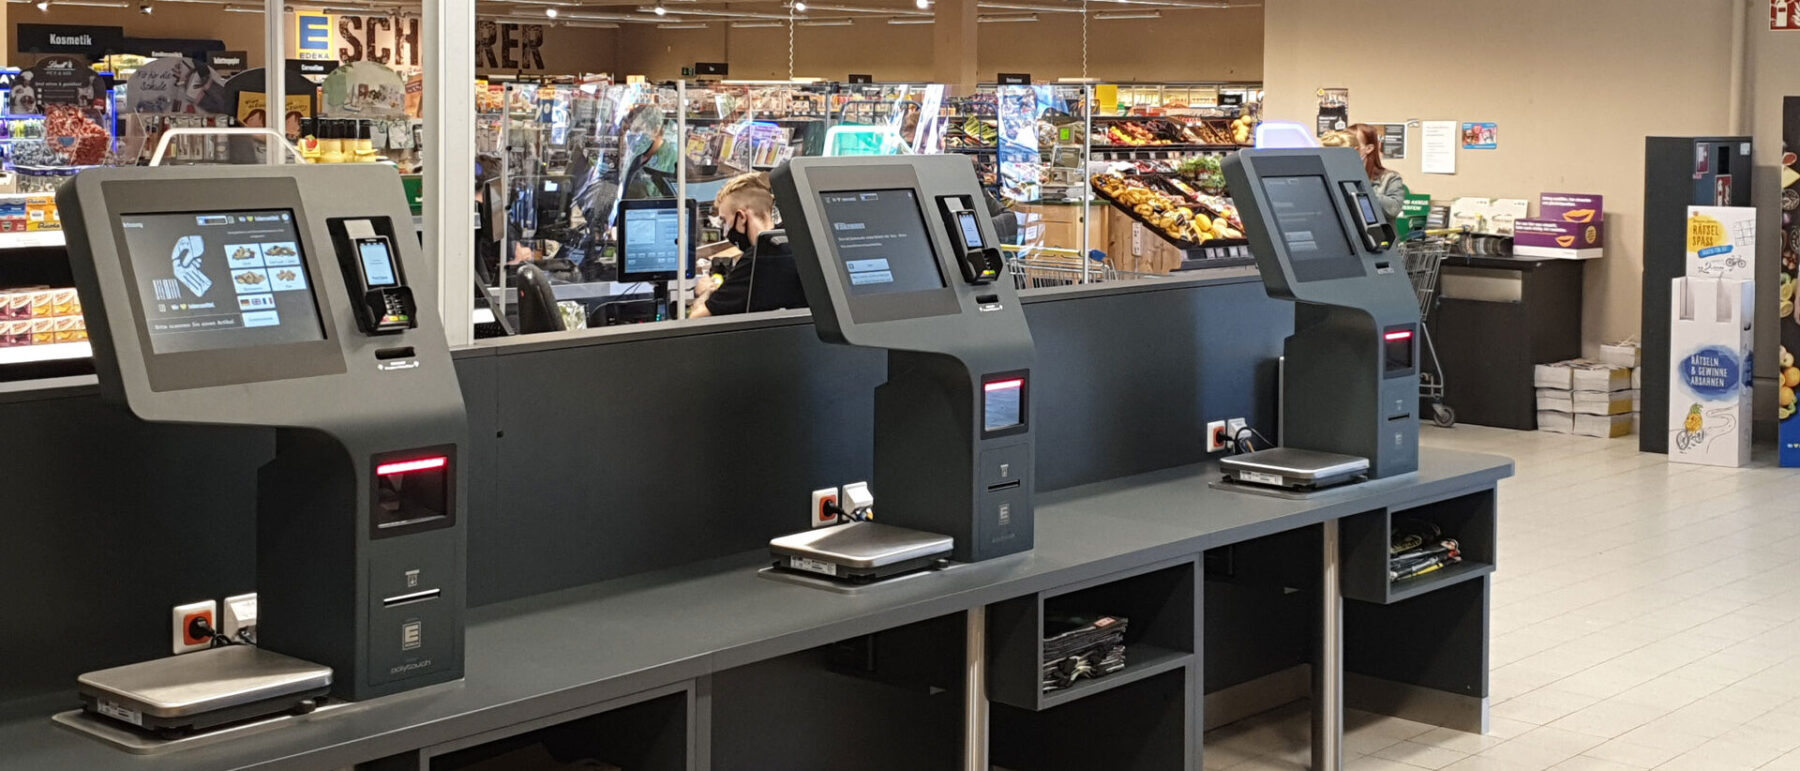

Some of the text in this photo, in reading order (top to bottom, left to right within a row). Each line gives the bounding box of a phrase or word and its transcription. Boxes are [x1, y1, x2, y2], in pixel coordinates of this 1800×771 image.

[50, 33, 92, 46] Kosmetik
[1692, 236, 1713, 246] SPASS
[1691, 354, 1719, 367] RÄTSELN
[1698, 366, 1728, 378] GEWINNE
[1691, 376, 1725, 388] ABSAHNEN
